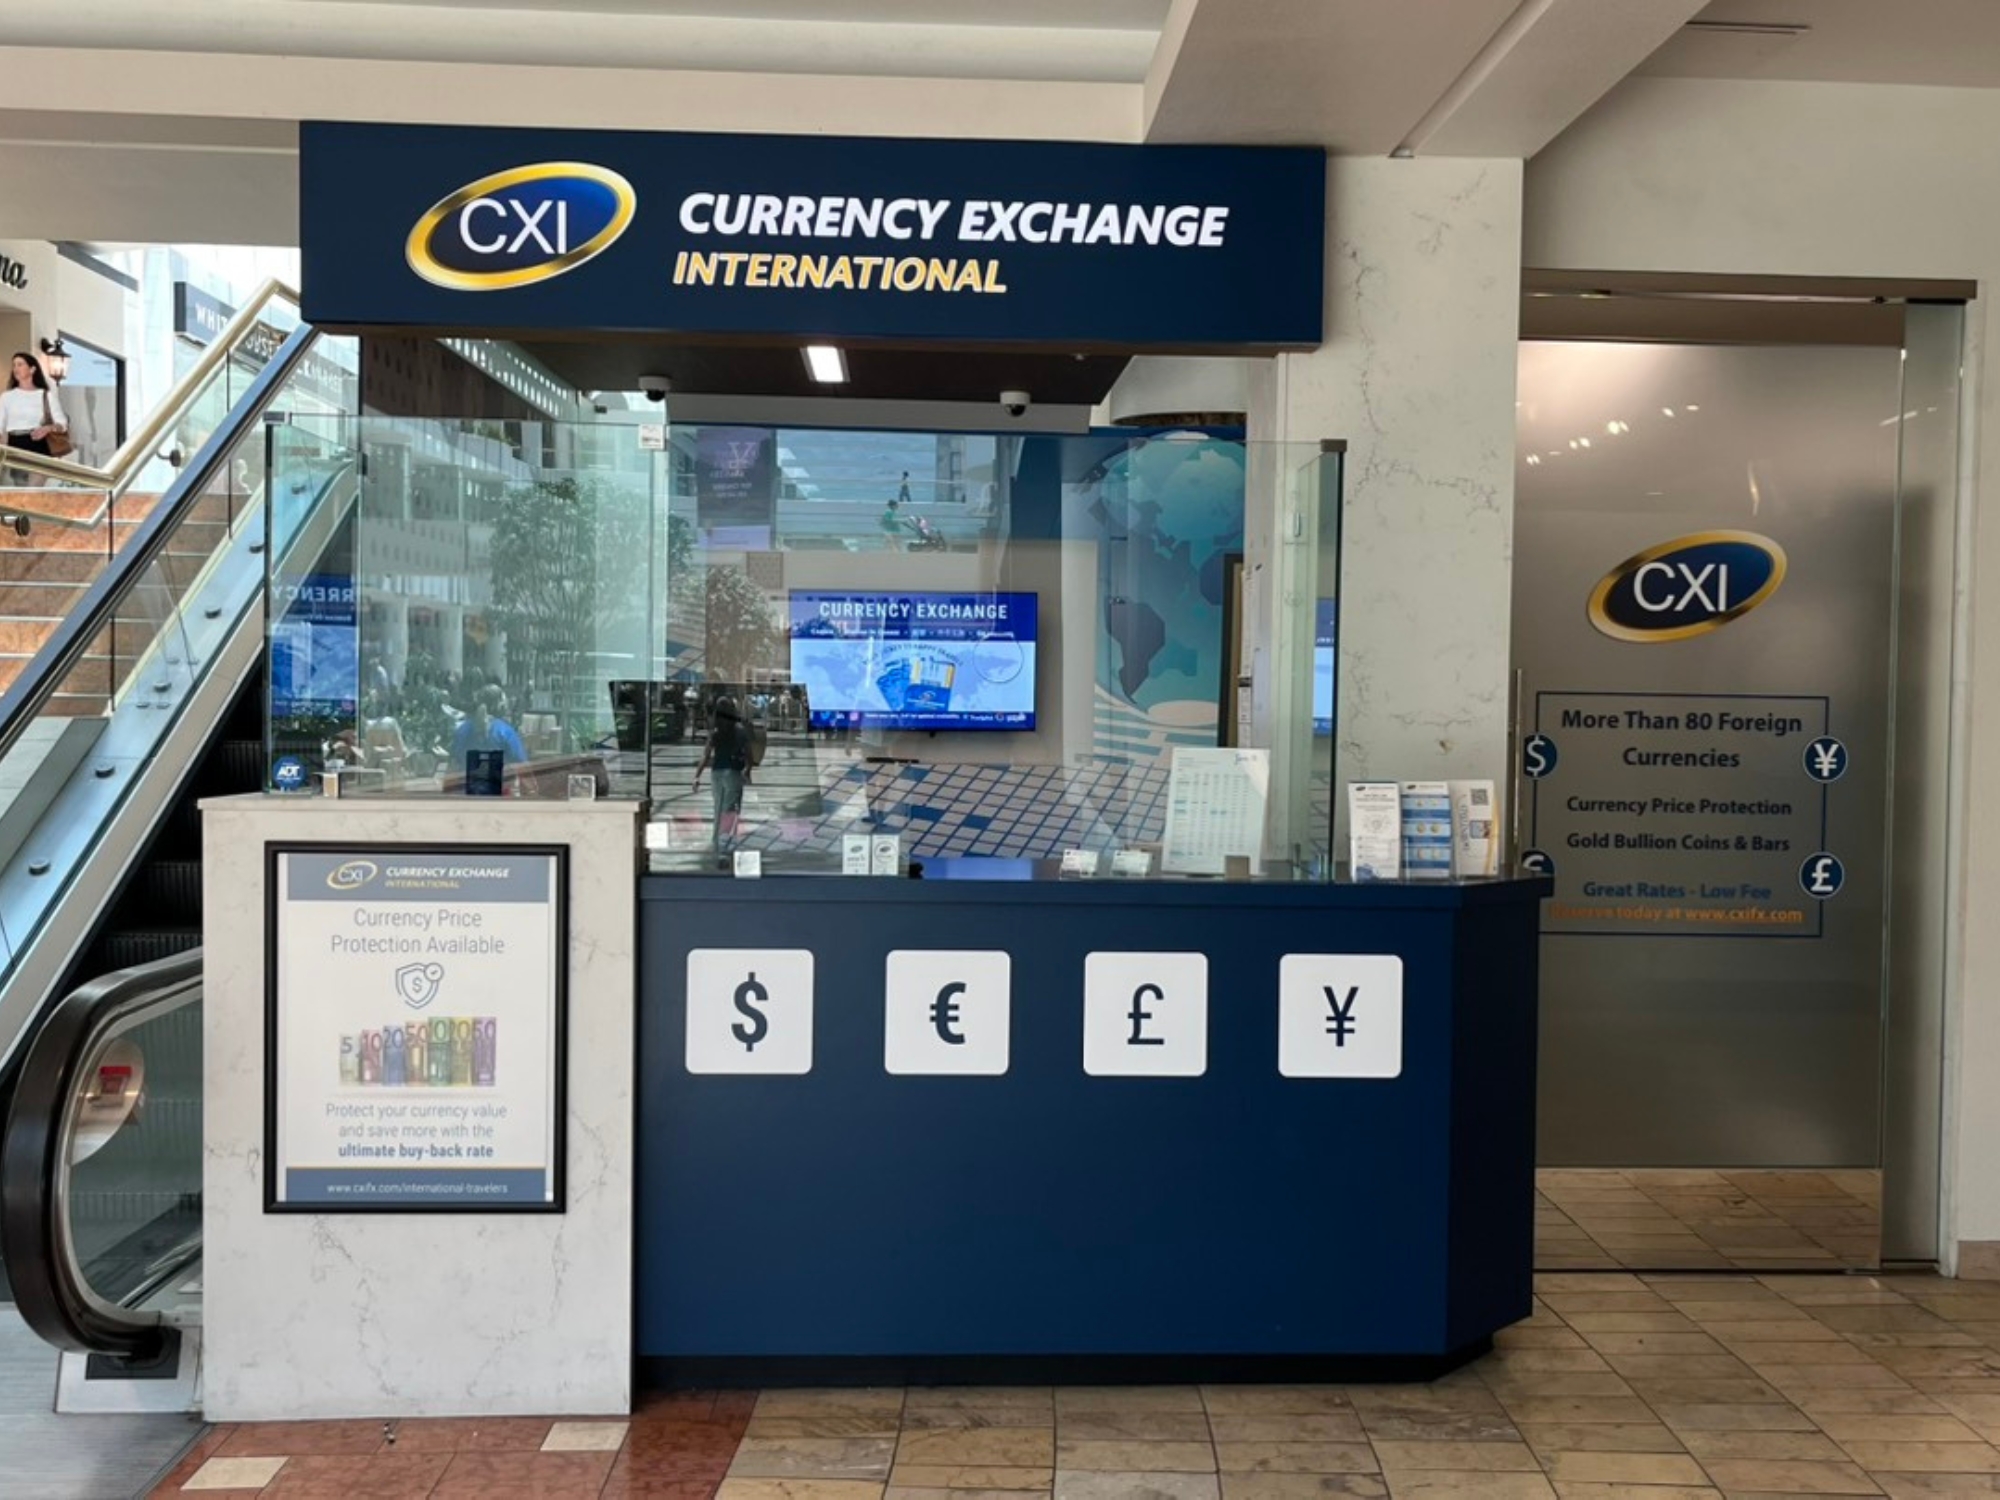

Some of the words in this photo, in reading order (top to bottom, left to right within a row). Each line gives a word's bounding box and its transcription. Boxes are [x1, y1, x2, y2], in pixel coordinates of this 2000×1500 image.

[459, 198, 567, 255] CXI
[679, 193, 950, 241] CURRENCY
[957, 201, 1229, 247] EXCHANGE
[672, 251, 1008, 294] INTERNATIONAL
[1633, 561, 1728, 613] CXI
[819, 602, 910, 618] CURRENCY
[916, 602, 1008, 619] EXCHANGE
[1561, 710, 1620, 730] More
[1624, 710, 1680, 730] Than
[1685, 713, 1713, 731] 80
[1719, 712, 1802, 737] Foreign
[1526, 735, 1547, 776] $
[1622, 748, 1740, 768] Currencies
[1814, 743, 1839, 777] ¥
[276, 765, 300, 777] ADT
[1567, 796, 1648, 816] Currency
[1652, 798, 1696, 814] Price
[1700, 798, 1792, 815] Protection
[1567, 833, 1609, 849] Gold
[1614, 833, 1677, 850] Bullion
[1681, 834, 1729, 851] Coins
[1734, 835, 1747, 851] &
[1752, 836, 1790, 851] Bars
[338, 868, 363, 882] CXI
[386, 866, 447, 877] CURRENCY
[448, 867, 510, 878] EXCHANGE
[1811, 858, 1834, 891] £
[384, 880, 460, 889] INTERNATIONAL
[1583, 881, 1632, 898] Great
[1637, 882, 1686, 899] Rates
[1700, 883, 1737, 899] Low
[1741, 883, 1772, 900] Fee
[354, 908, 433, 931] Currency
[438, 909, 482, 928] Price
[1616, 906, 1662, 922] today
[1665, 907, 1682, 920] at
[1685, 907, 1804, 923] www.cxifx.com
[331, 935, 421, 953] Protection
[427, 935, 505, 954] Available
[731, 971, 769, 1052] $
[929, 981, 967, 1044] €
[1127, 982, 1165, 1045] £
[1323, 985, 1359, 1047] ¥
[325, 1104, 374, 1118] Protect
[377, 1107, 409, 1122] your
[411, 1106, 469, 1122] currency
[472, 1104, 508, 1118] value
[339, 1124, 364, 1138] and
[367, 1127, 399, 1138] save
[402, 1127, 438, 1138] more
[440, 1124, 470, 1138] with
[472, 1124, 494, 1138] the
[338, 1143, 396, 1158] ultimate
[399, 1143, 462, 1160] buy-back
[466, 1144, 494, 1158] rate
[327, 1182, 508, 1194] www.cxifx.com/international-travelers
